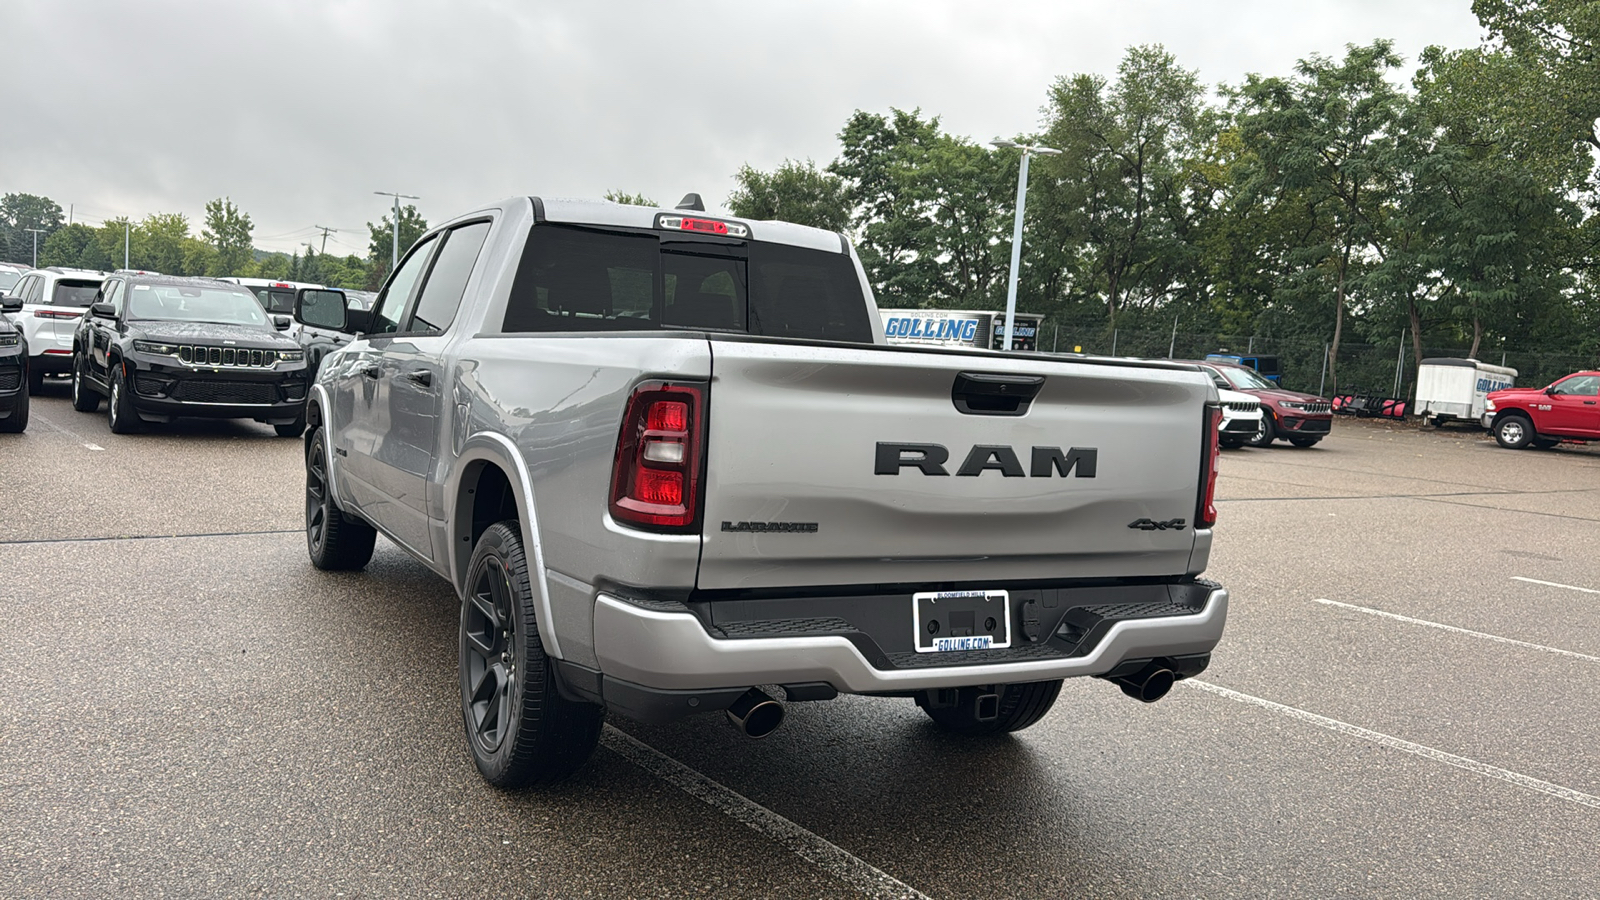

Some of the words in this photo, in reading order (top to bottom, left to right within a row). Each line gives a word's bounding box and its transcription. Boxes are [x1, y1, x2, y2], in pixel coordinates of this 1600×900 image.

[885, 318, 979, 341] GOLLING
[874, 441, 1098, 478] RAM
[721, 521, 818, 533] LARAMIE
[1127, 518, 1187, 531] 4x4
[938, 637, 989, 651] GOLLING.COM
